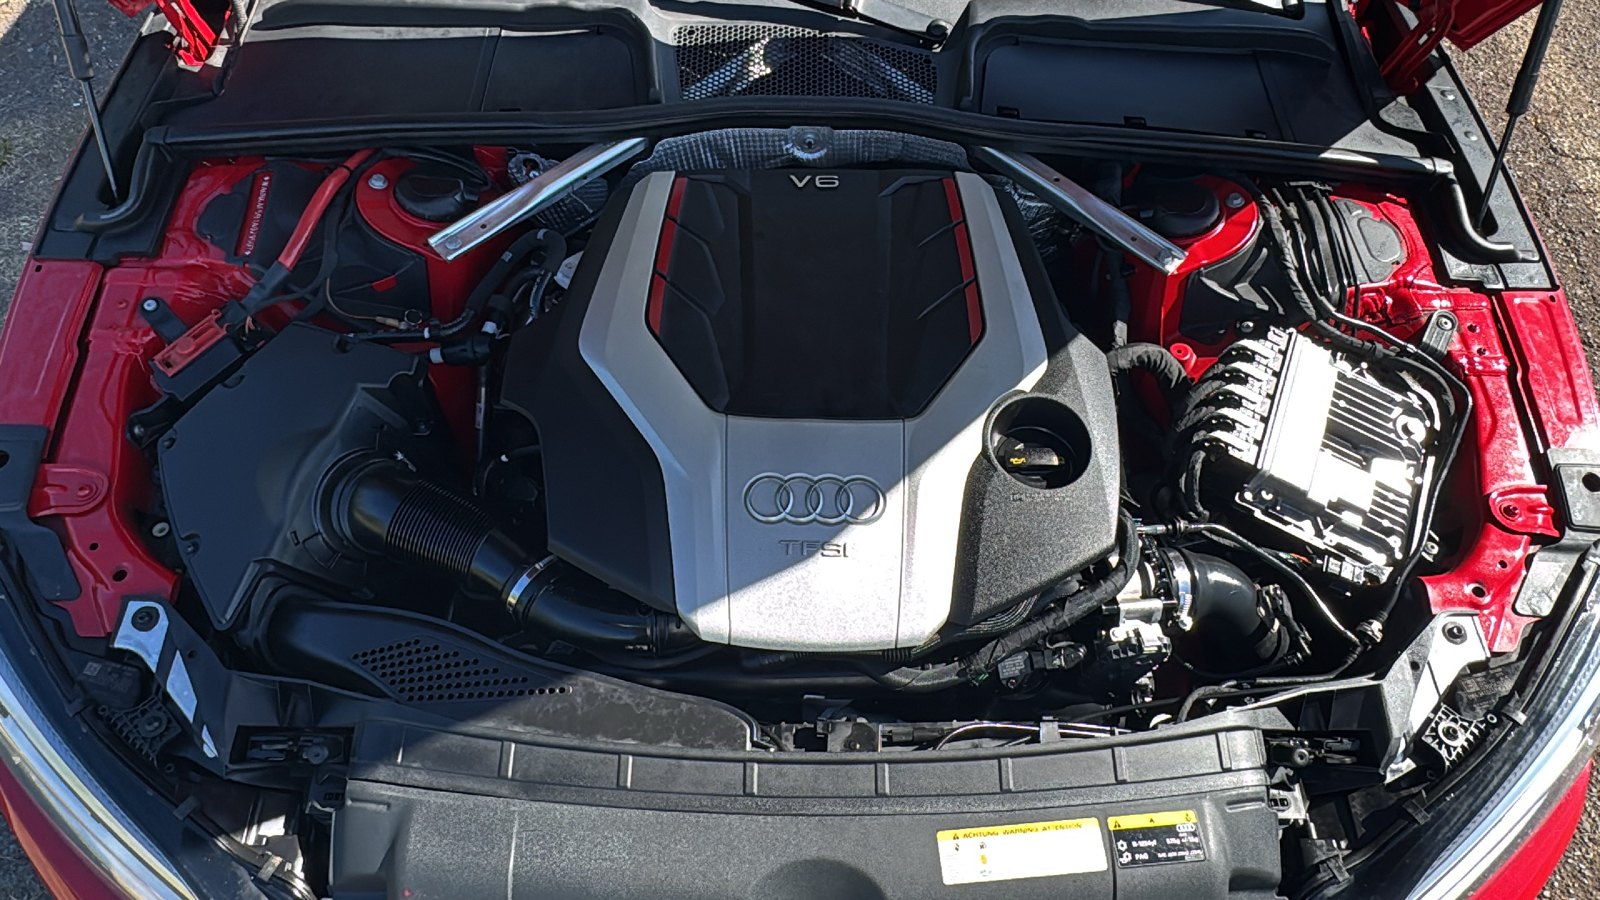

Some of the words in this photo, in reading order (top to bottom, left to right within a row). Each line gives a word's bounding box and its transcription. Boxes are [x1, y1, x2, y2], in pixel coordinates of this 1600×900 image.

[789, 174, 840, 188] V6
[779, 540, 849, 558] TFSI
[963, 831, 999, 839] ACHTUNG
[1002, 826, 1038, 836] WARNING
[1042, 822, 1082, 832] ATTENTION
